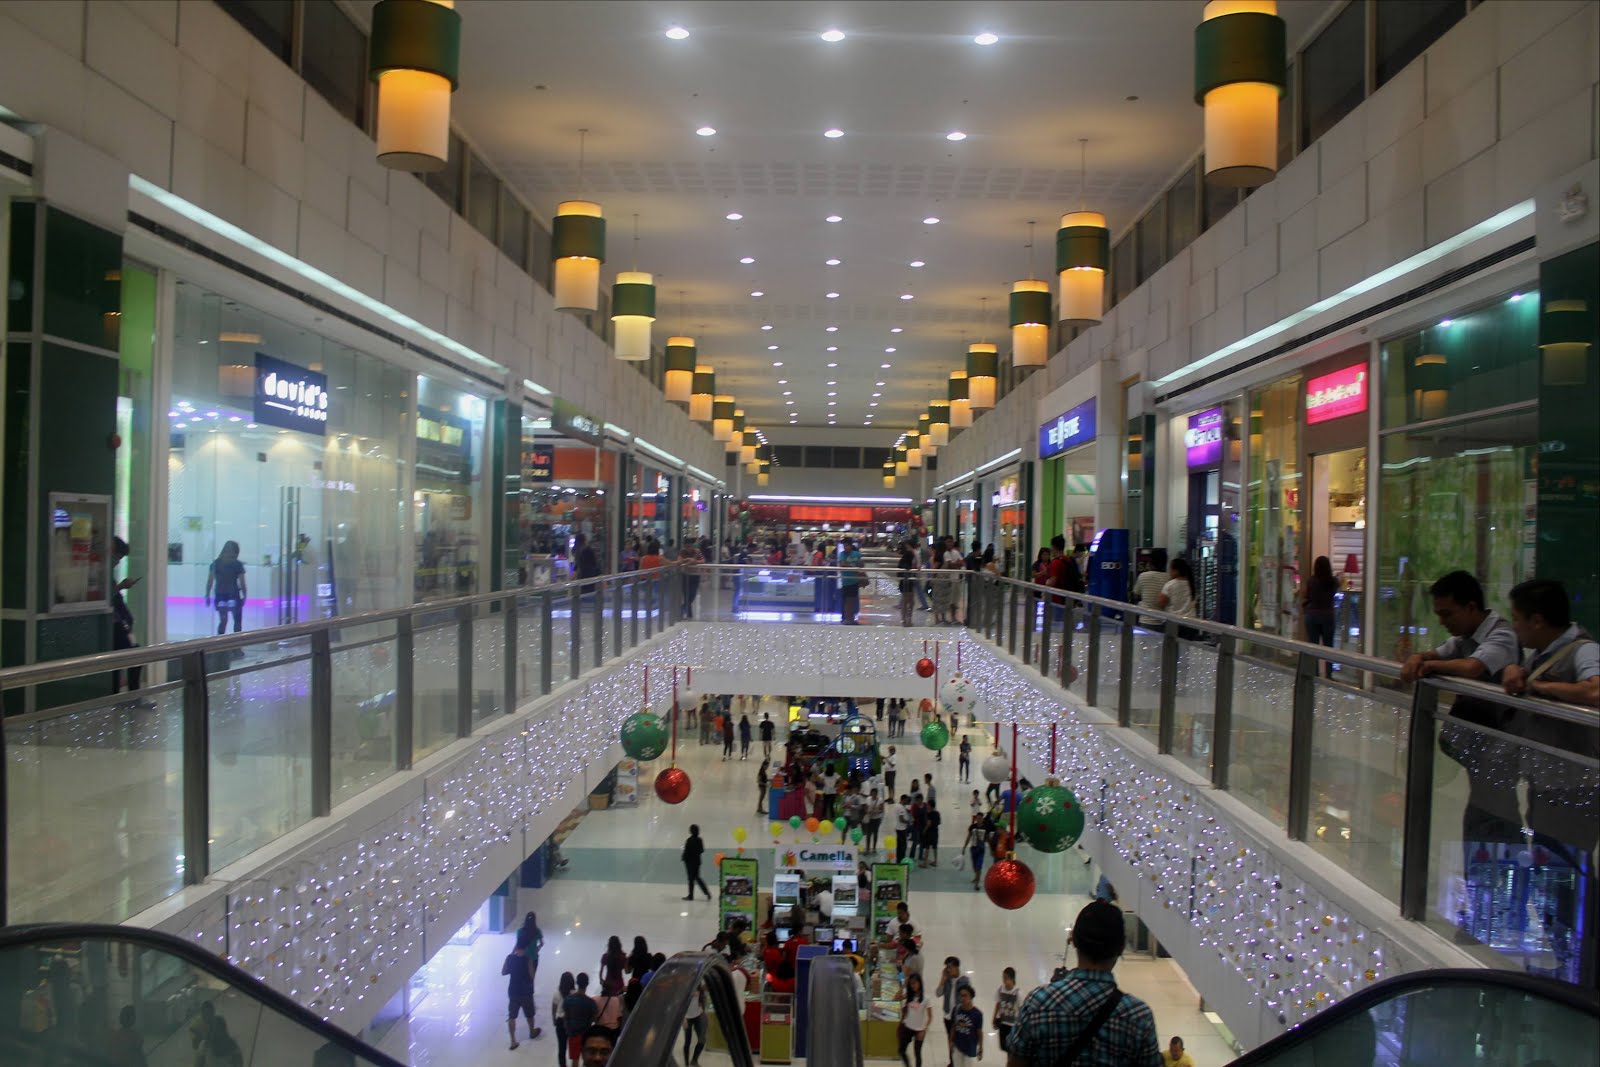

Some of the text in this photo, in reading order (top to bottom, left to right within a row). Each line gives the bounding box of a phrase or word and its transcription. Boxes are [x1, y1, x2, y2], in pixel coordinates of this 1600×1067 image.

[264, 372, 328, 409] david's
[1101, 561, 1121, 570] BDO
[799, 849, 853, 862] Camella
